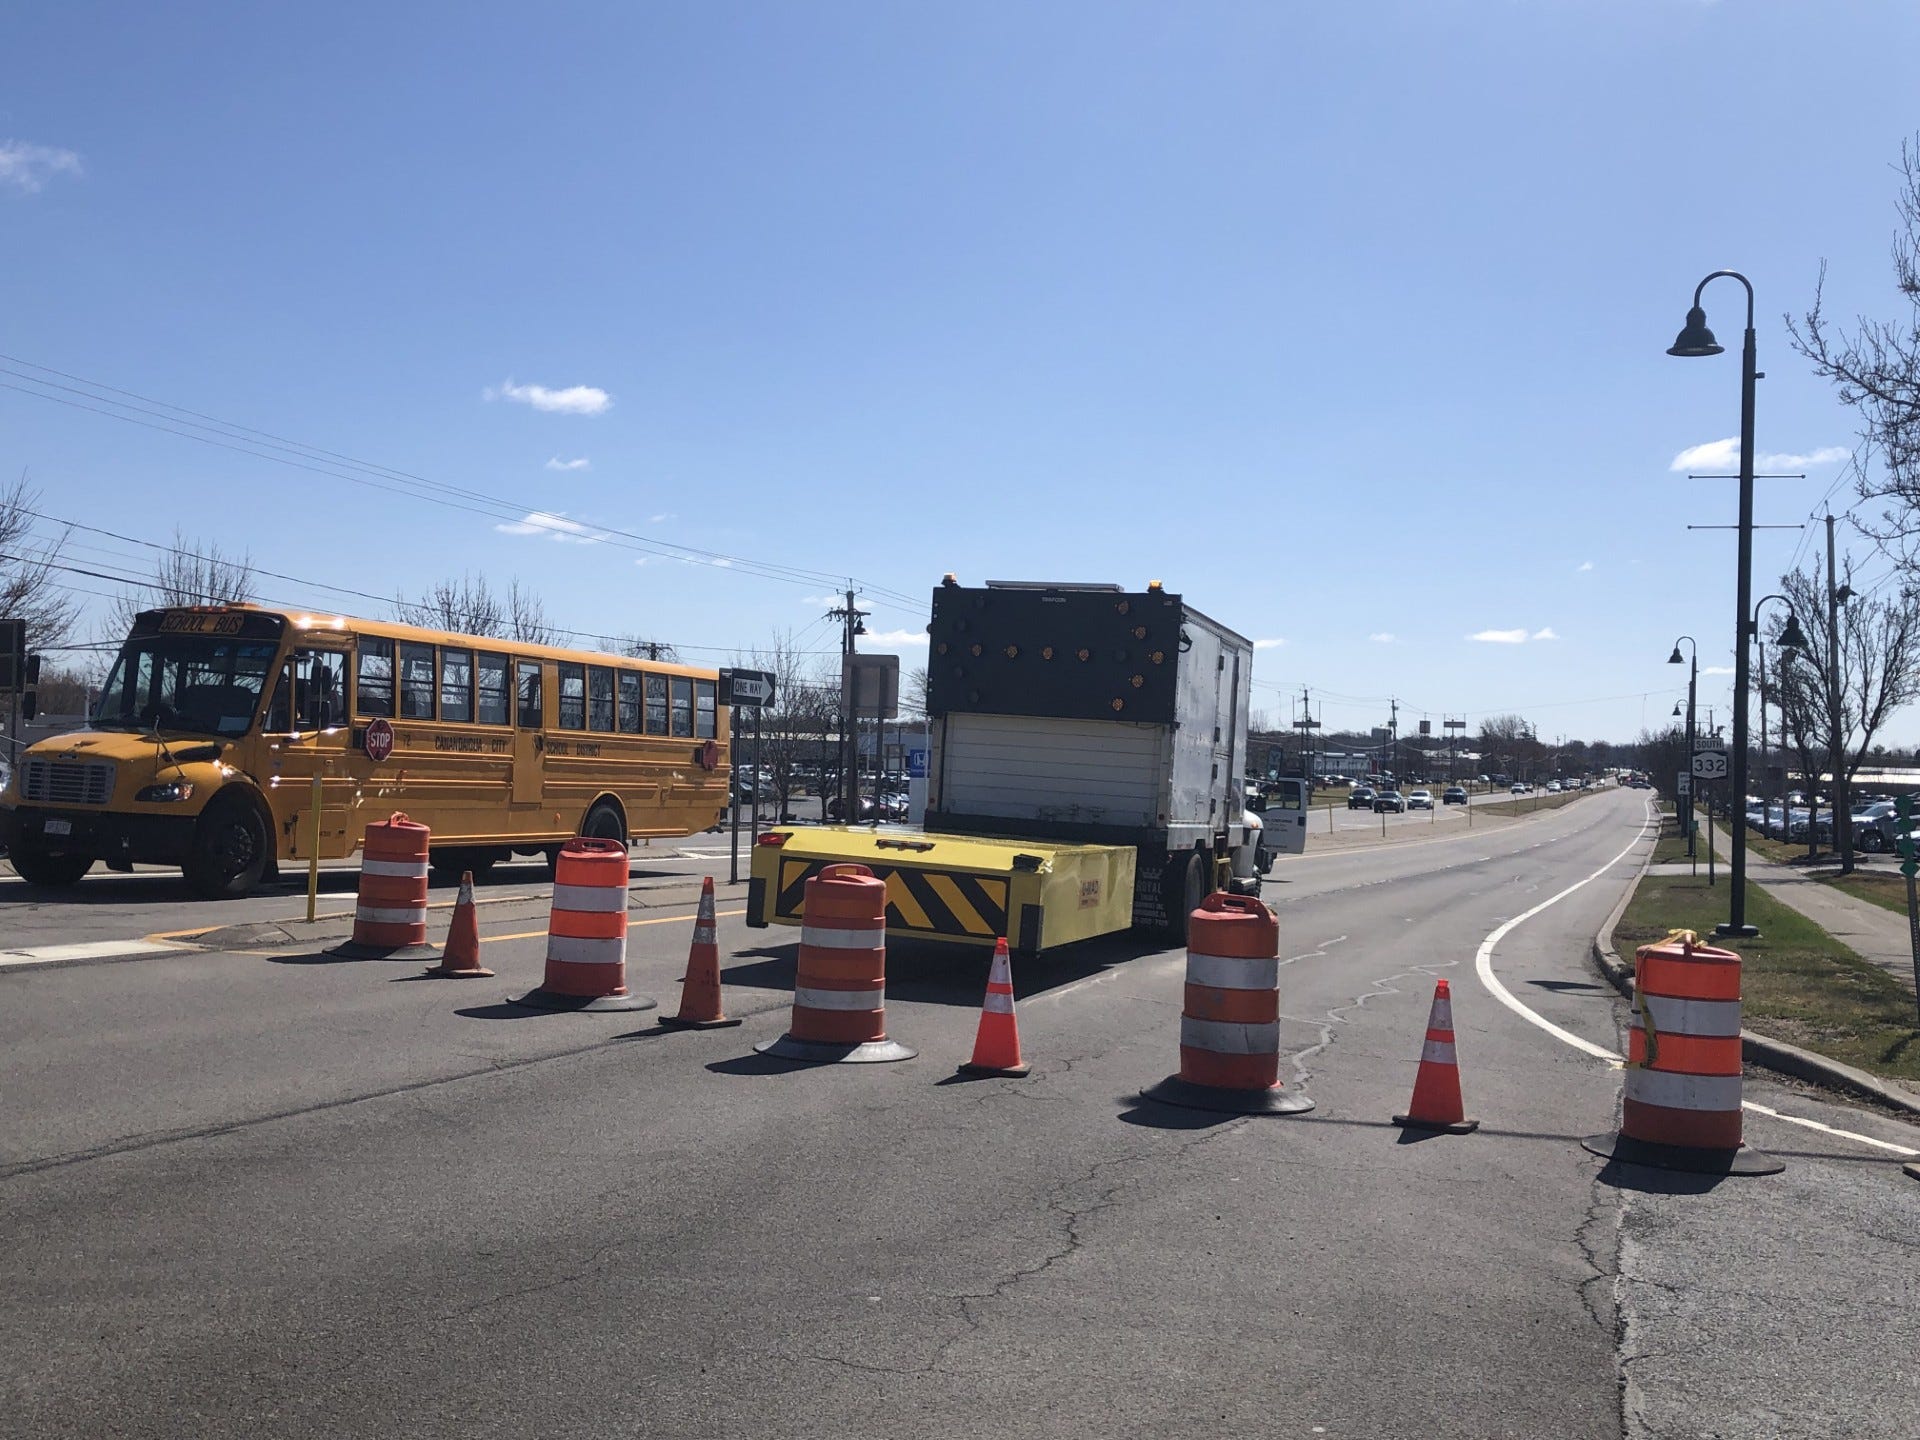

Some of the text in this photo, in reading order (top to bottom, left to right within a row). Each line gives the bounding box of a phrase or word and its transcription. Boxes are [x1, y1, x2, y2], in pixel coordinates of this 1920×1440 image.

[161, 615, 242, 632] SCHOOL BUS
[735, 680, 762, 696] ONE WAY
[370, 732, 391, 748] STOP
[491, 739, 508, 753] CITY
[1696, 740, 1722, 749] SOUTH
[1694, 759, 1725, 772] 332
